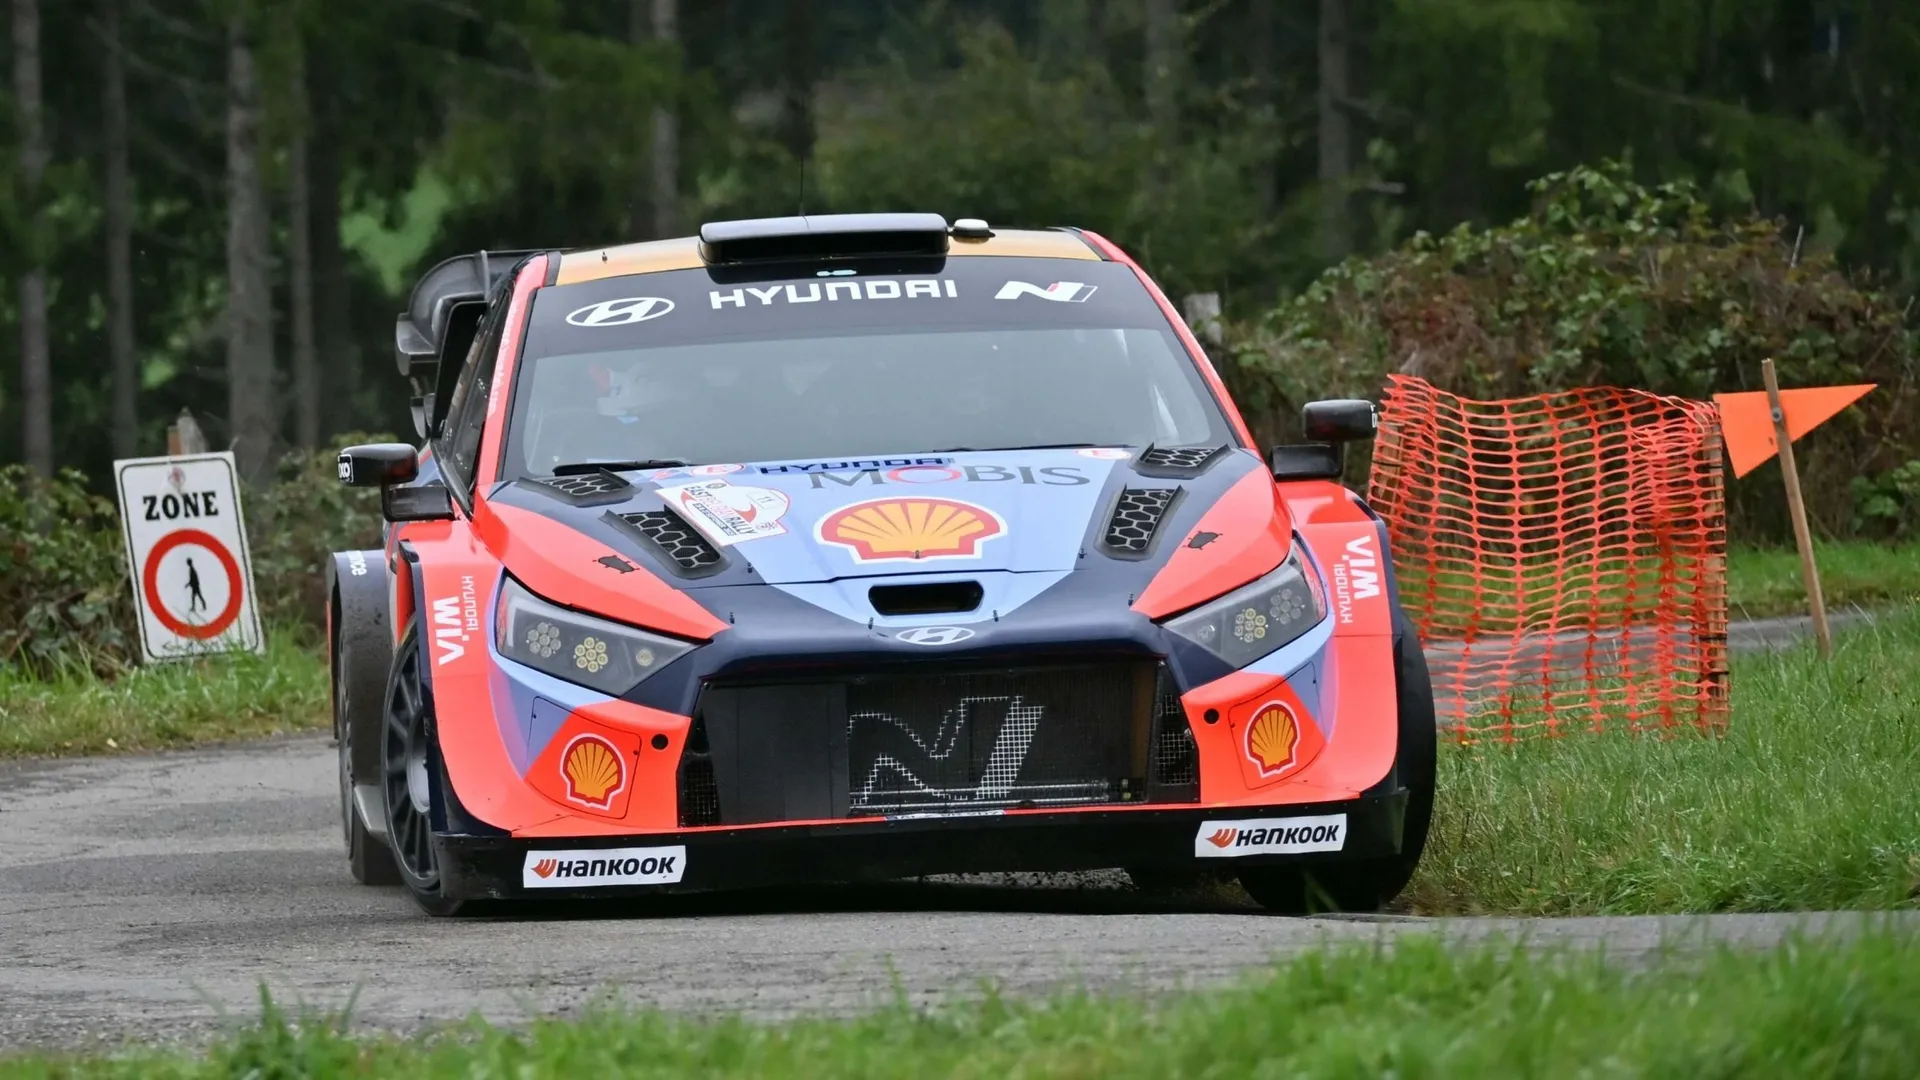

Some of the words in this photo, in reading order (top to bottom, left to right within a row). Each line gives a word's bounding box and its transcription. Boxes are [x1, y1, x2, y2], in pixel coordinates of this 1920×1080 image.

[709, 279, 958, 309] HYUNDAI
[808, 464, 1091, 489] MOBIS
[143, 491, 219, 521] ZONE
[723, 516, 758, 535] RALLY
[461, 575, 479, 631] HYUNDAI
[1333, 564, 1354, 624] HYUNDAI
[1235, 825, 1340, 847] HANKOOK
[555, 856, 676, 878] HANKOOK
